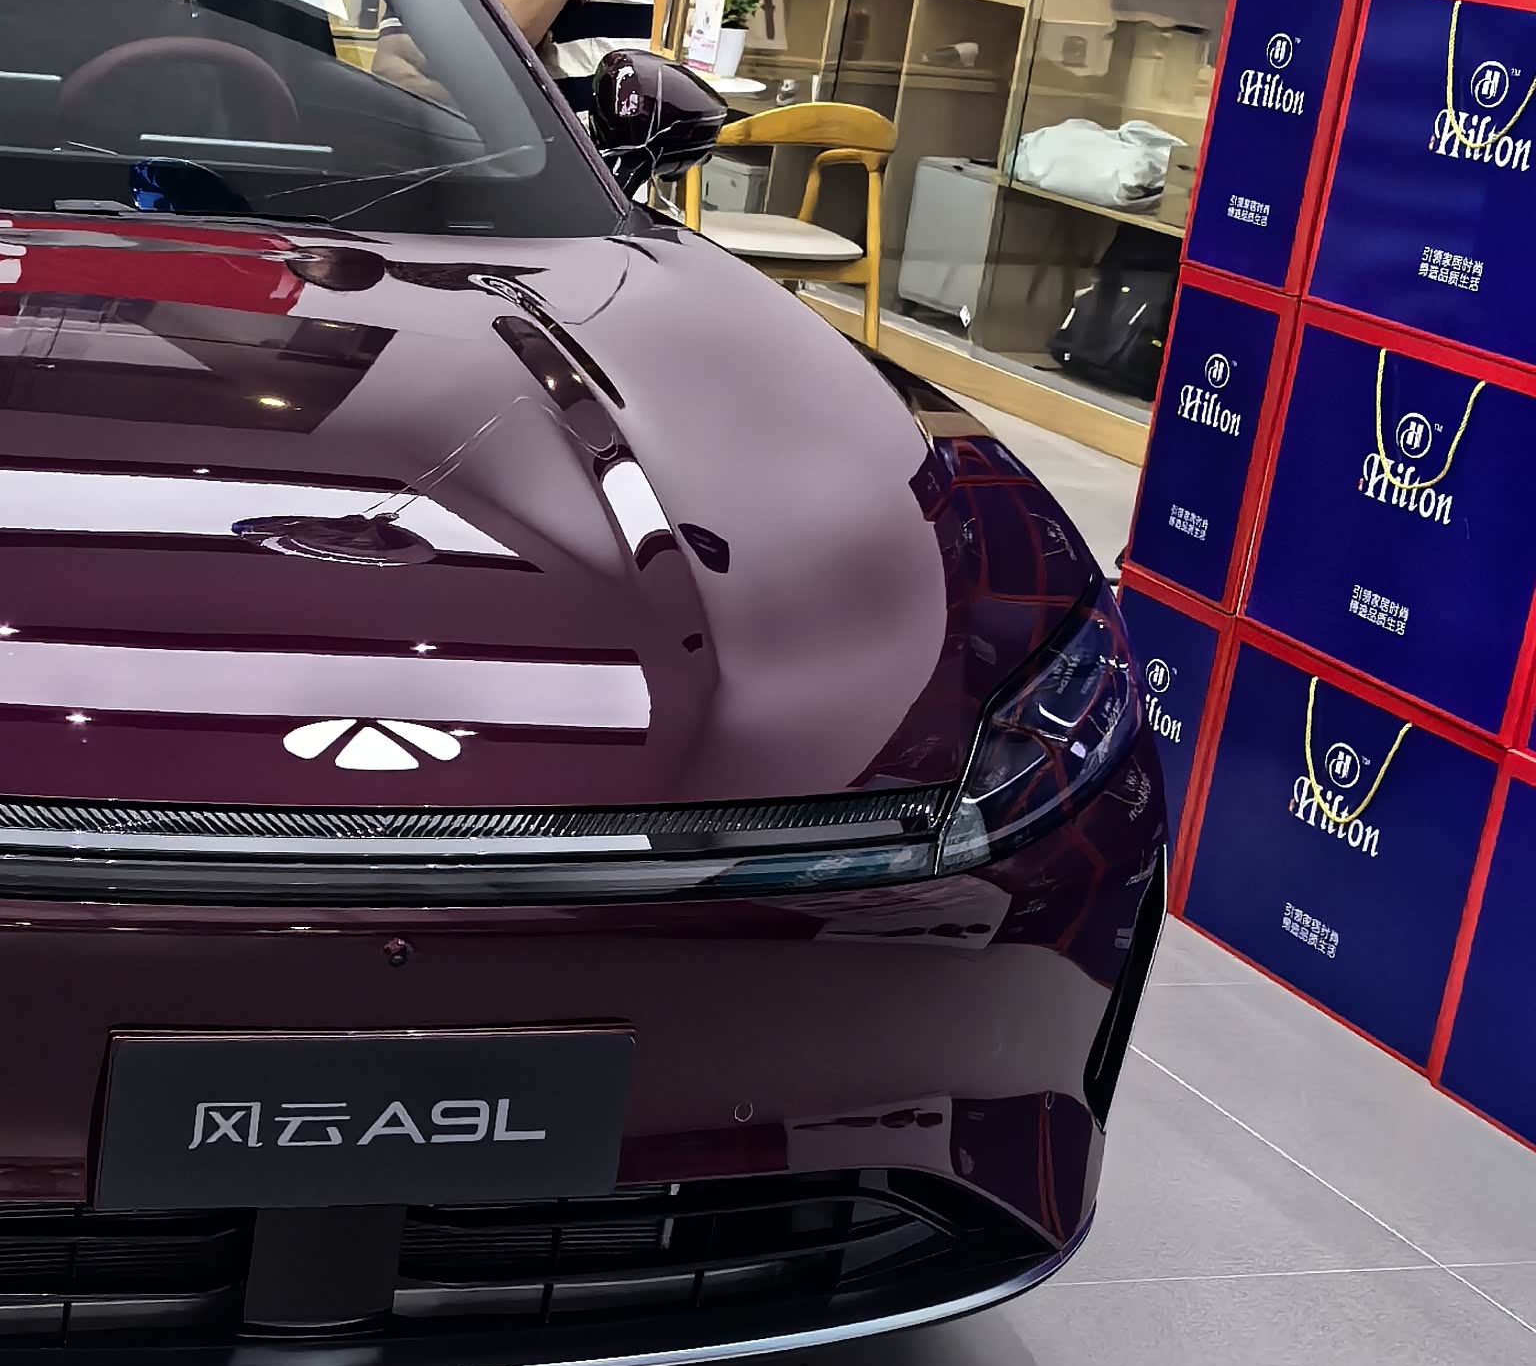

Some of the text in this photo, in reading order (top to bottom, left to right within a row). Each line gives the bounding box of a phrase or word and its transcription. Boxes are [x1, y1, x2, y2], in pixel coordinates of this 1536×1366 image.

[1237, 69, 1305, 116] Hilton
[1429, 108, 1533, 172] Hilton
[1178, 384, 1242, 437] Hilton
[1358, 452, 1453, 526] Hilton
[1145, 693, 1182, 744] ilton
[1288, 776, 1380, 858] Hilton
[188, 1097, 547, 1150] 风云A9L
